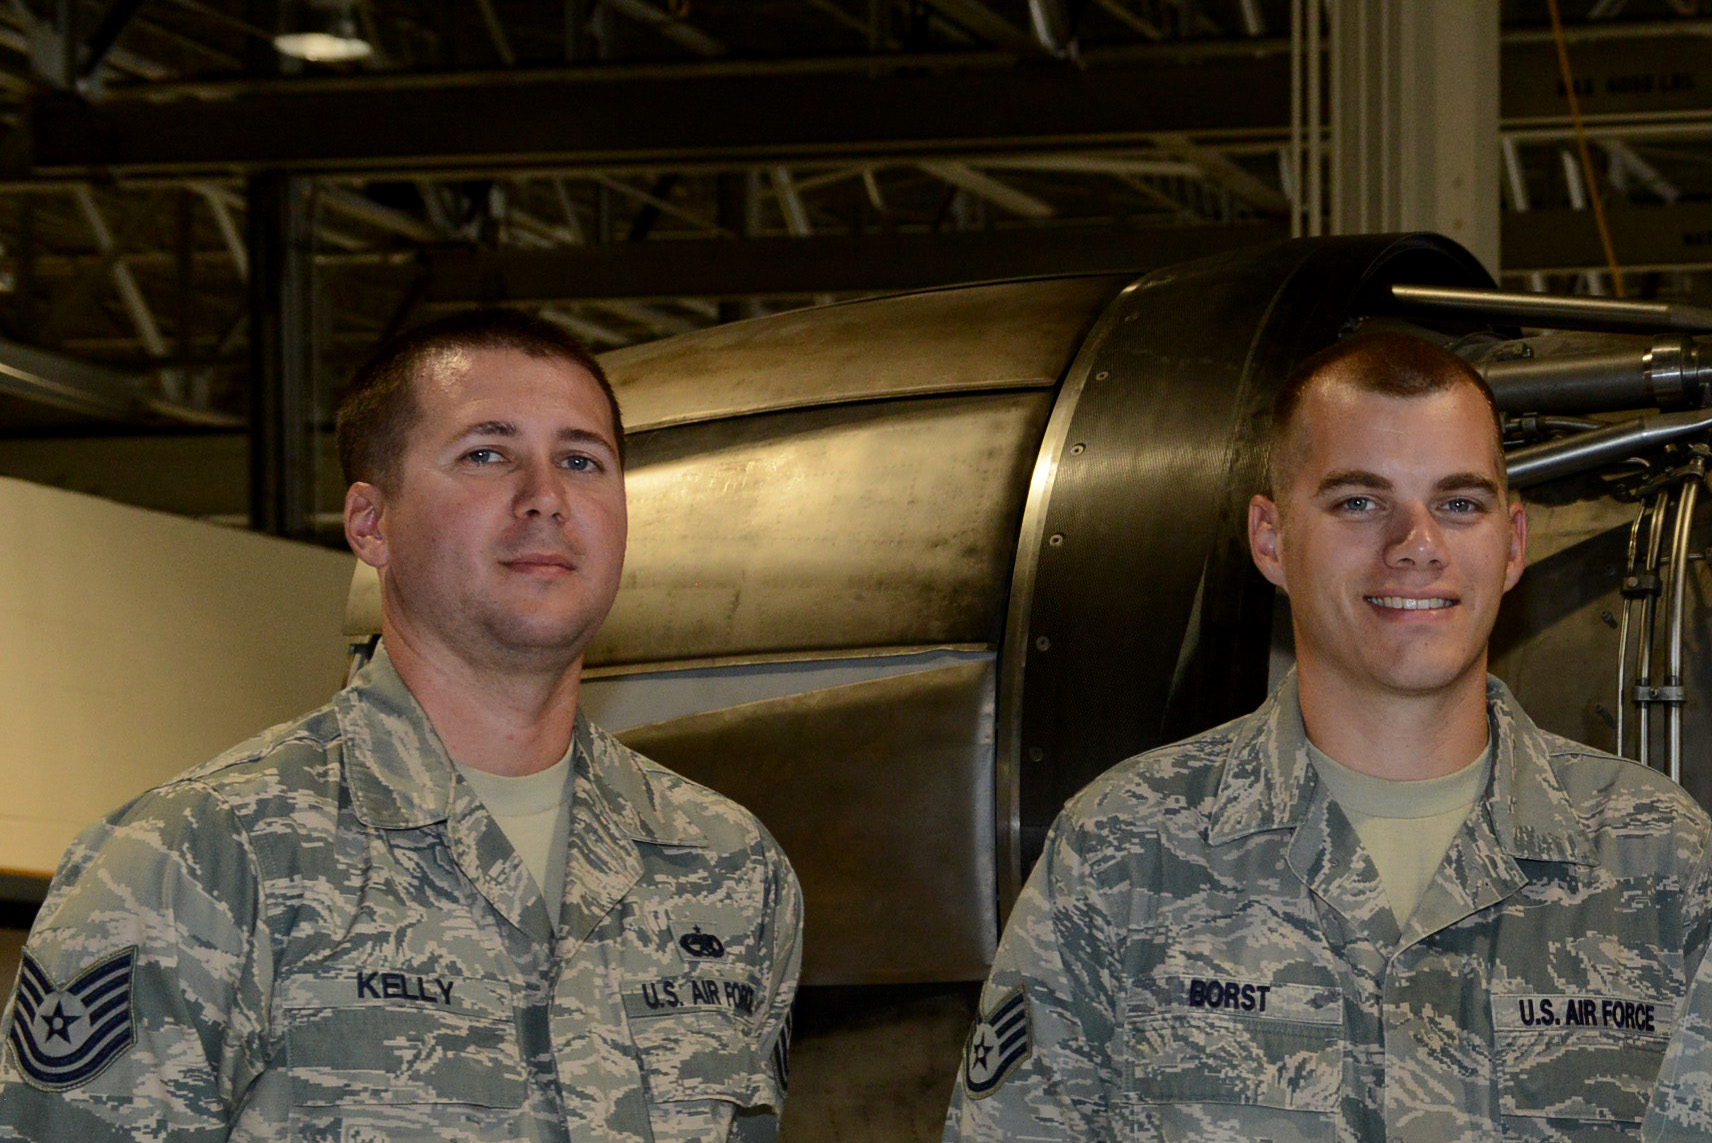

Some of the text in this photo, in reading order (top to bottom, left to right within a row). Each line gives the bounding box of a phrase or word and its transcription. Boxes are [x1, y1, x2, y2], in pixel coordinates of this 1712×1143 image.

[357, 971, 454, 1005] KELLY
[641, 980, 684, 1010] U.S.
[691, 979, 721, 1006] AIR
[1190, 979, 1270, 1012] BORST
[1519, 998, 1656, 1032] U.S. AIR FORCE
